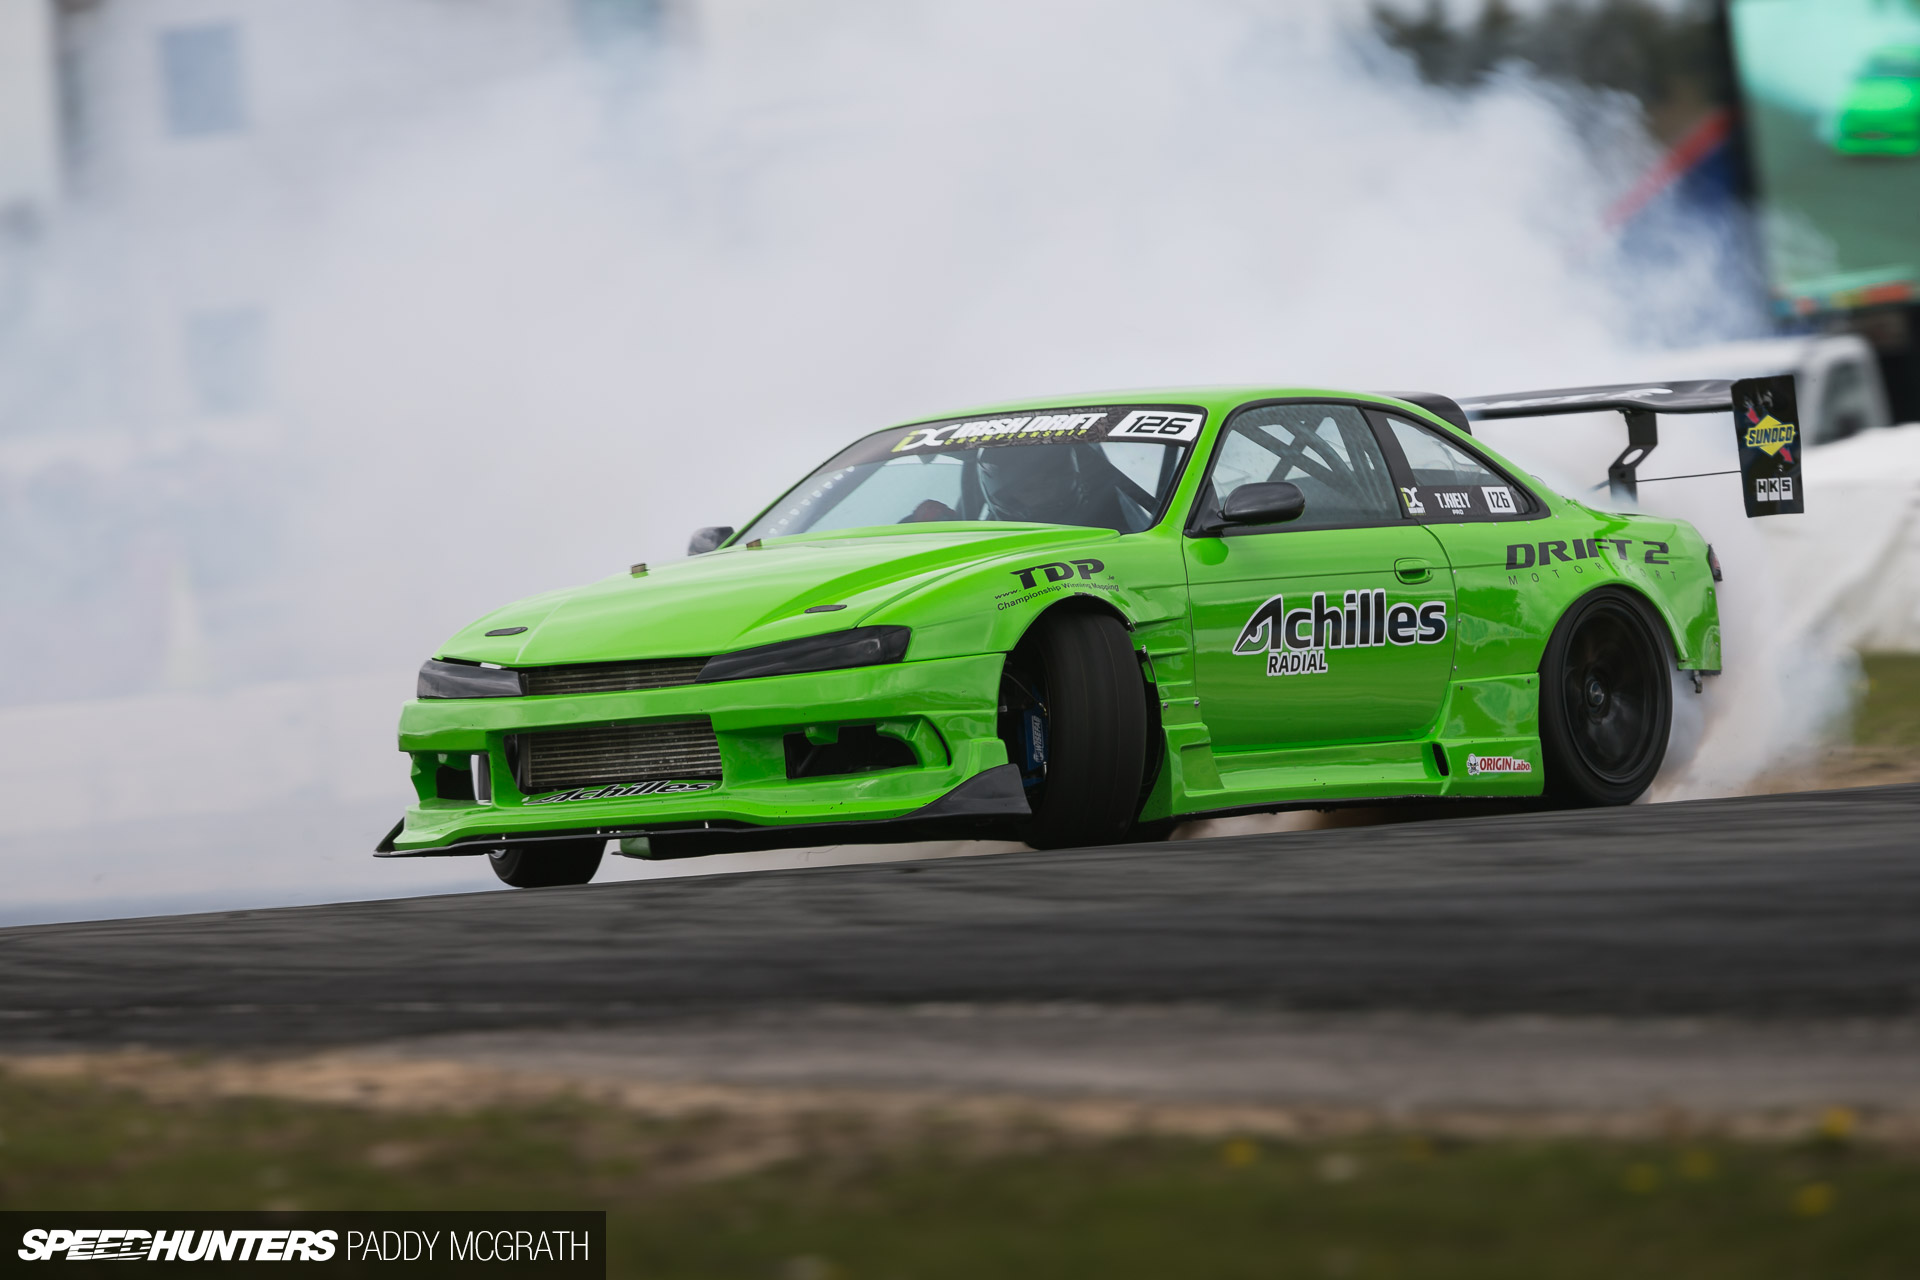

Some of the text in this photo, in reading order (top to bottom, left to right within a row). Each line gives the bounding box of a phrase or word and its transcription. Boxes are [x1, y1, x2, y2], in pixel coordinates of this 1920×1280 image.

[1021, 413, 1108, 433] DRIFT
[1125, 416, 1193, 434] 126
[944, 429, 1087, 445] CHAMPIONSHIP
[1748, 427, 1793, 445] SUNOCO
[1488, 492, 1510, 508] 126
[1757, 478, 1792, 500] HKS
[1506, 539, 1669, 570] DRIFT 2
[1010, 559, 1105, 590] TDP
[1508, 562, 1677, 586] MOTORSPORT
[997, 585, 1062, 611] Championship
[1233, 589, 1447, 655] Achilles
[1267, 651, 1328, 675] RADIAL
[1480, 758, 1511, 770] ORIGIN
[523, 780, 716, 805] Achilles
